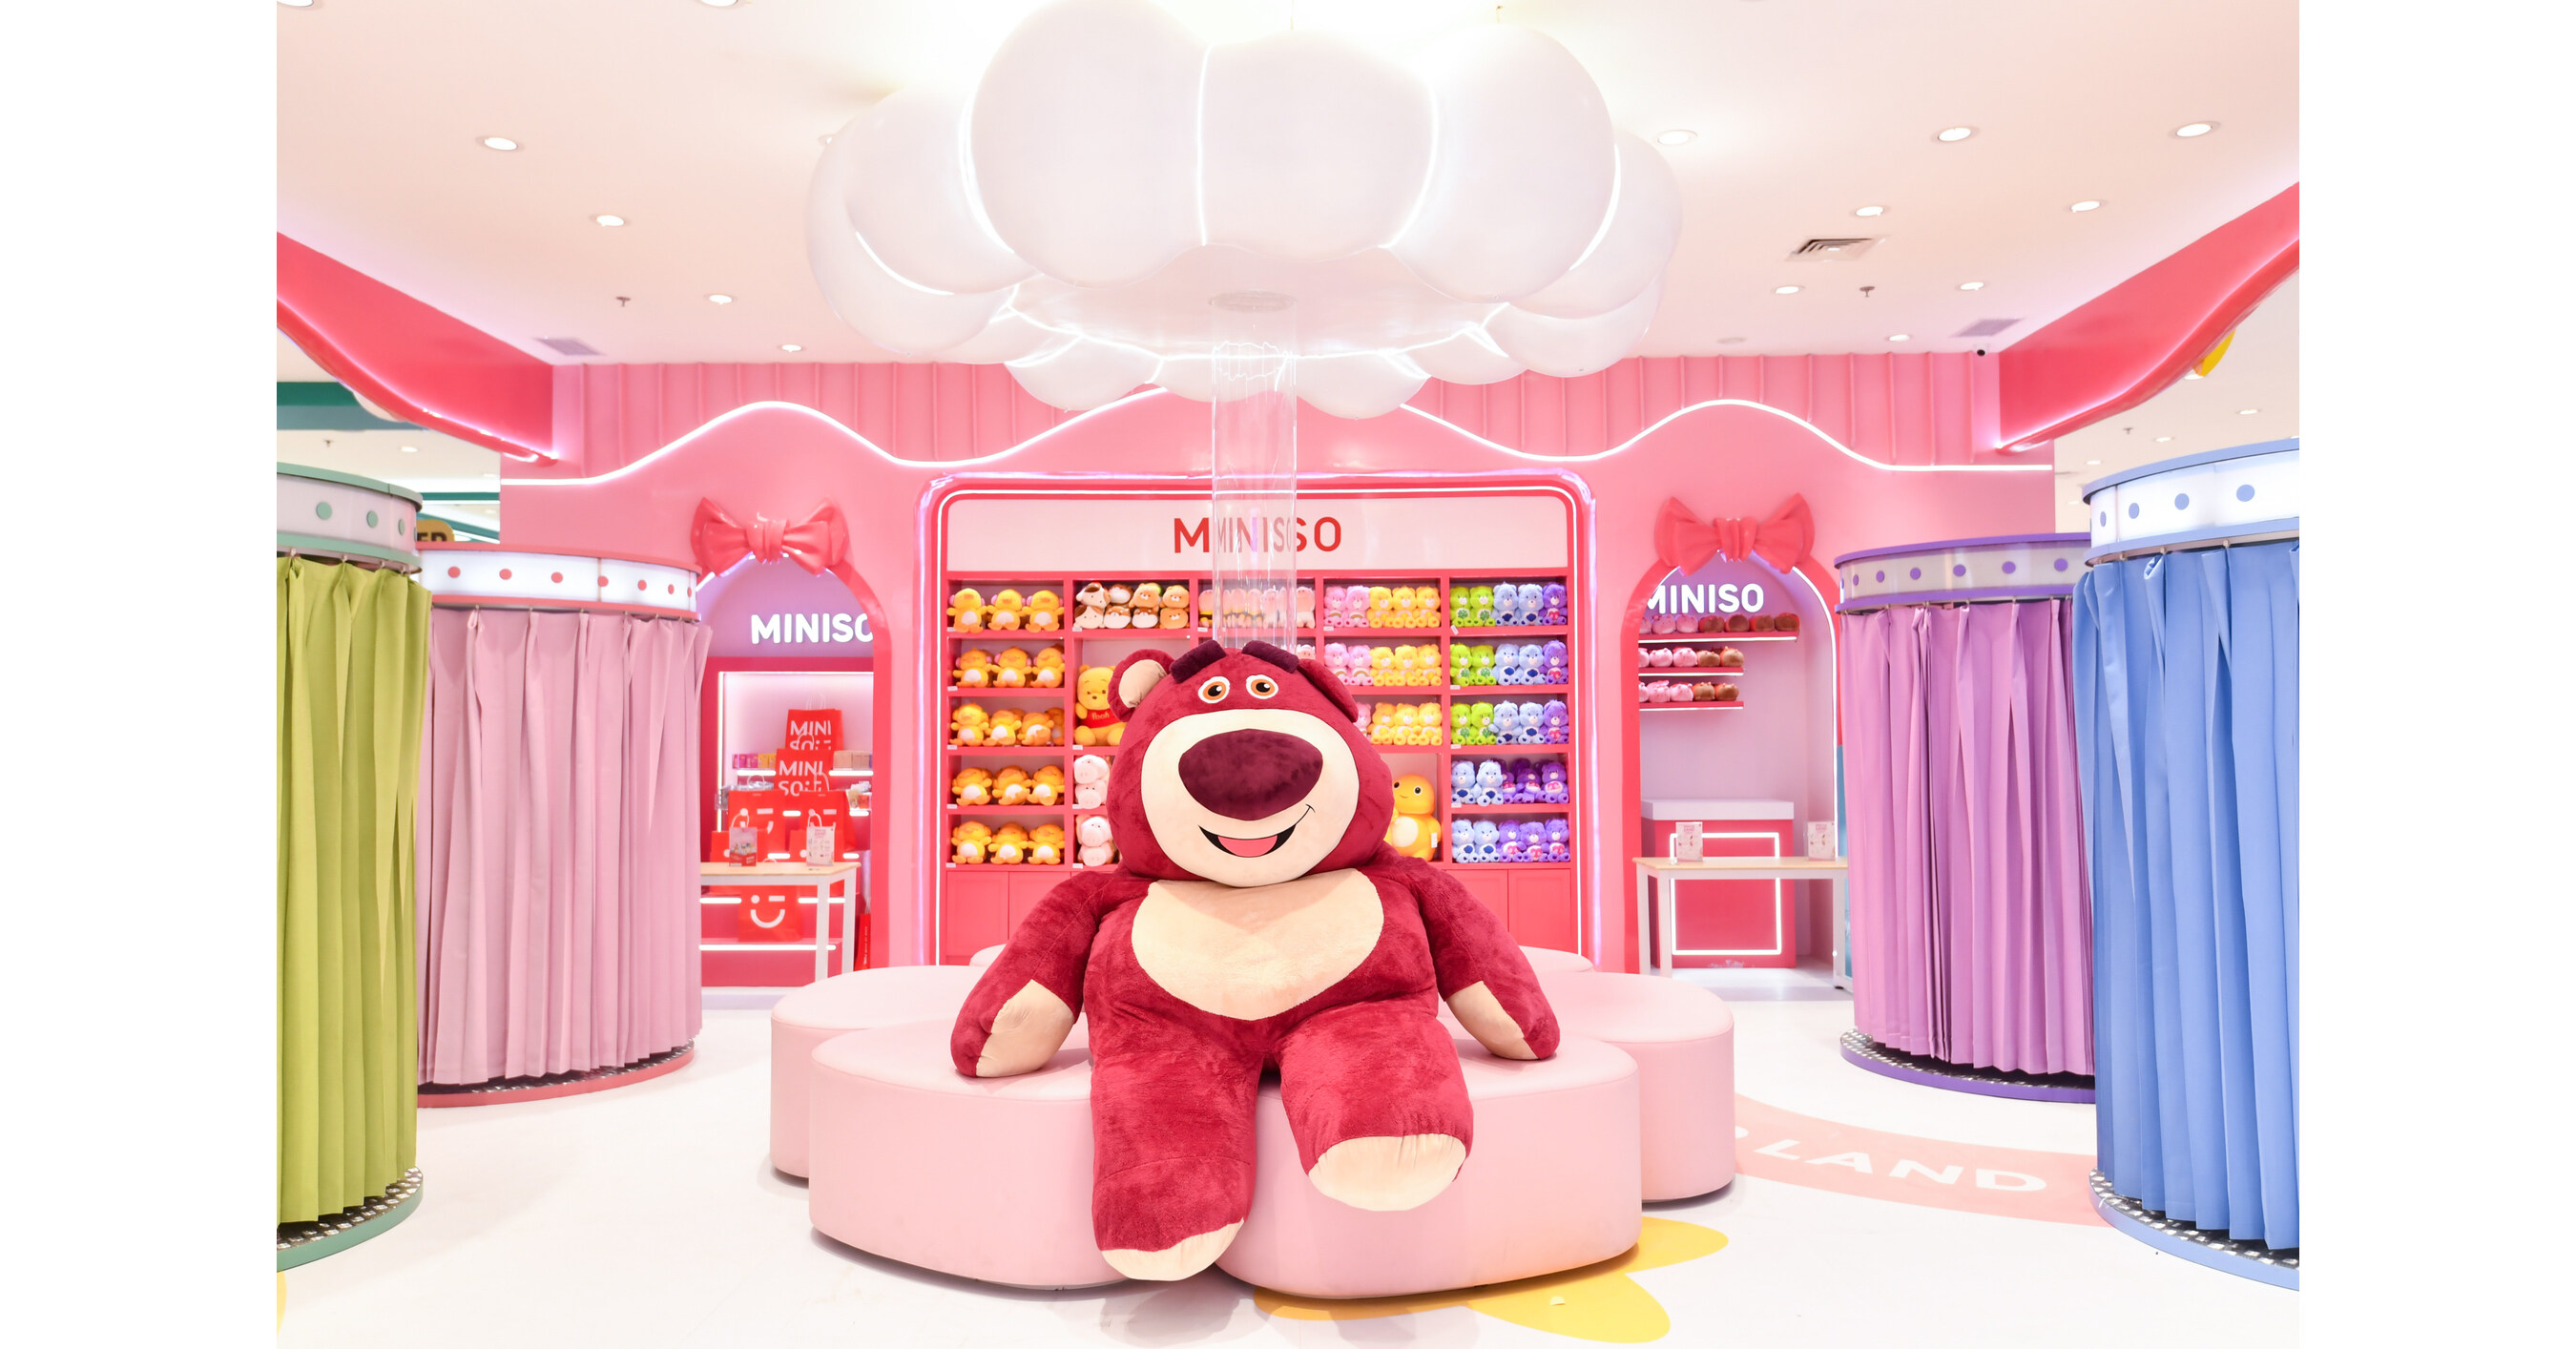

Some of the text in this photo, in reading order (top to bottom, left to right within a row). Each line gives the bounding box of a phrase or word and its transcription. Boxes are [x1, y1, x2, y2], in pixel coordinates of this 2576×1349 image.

[790, 719, 831, 736] MINI
[779, 760, 823, 777] MINI
[1753, 1138, 2047, 1192] LAND
